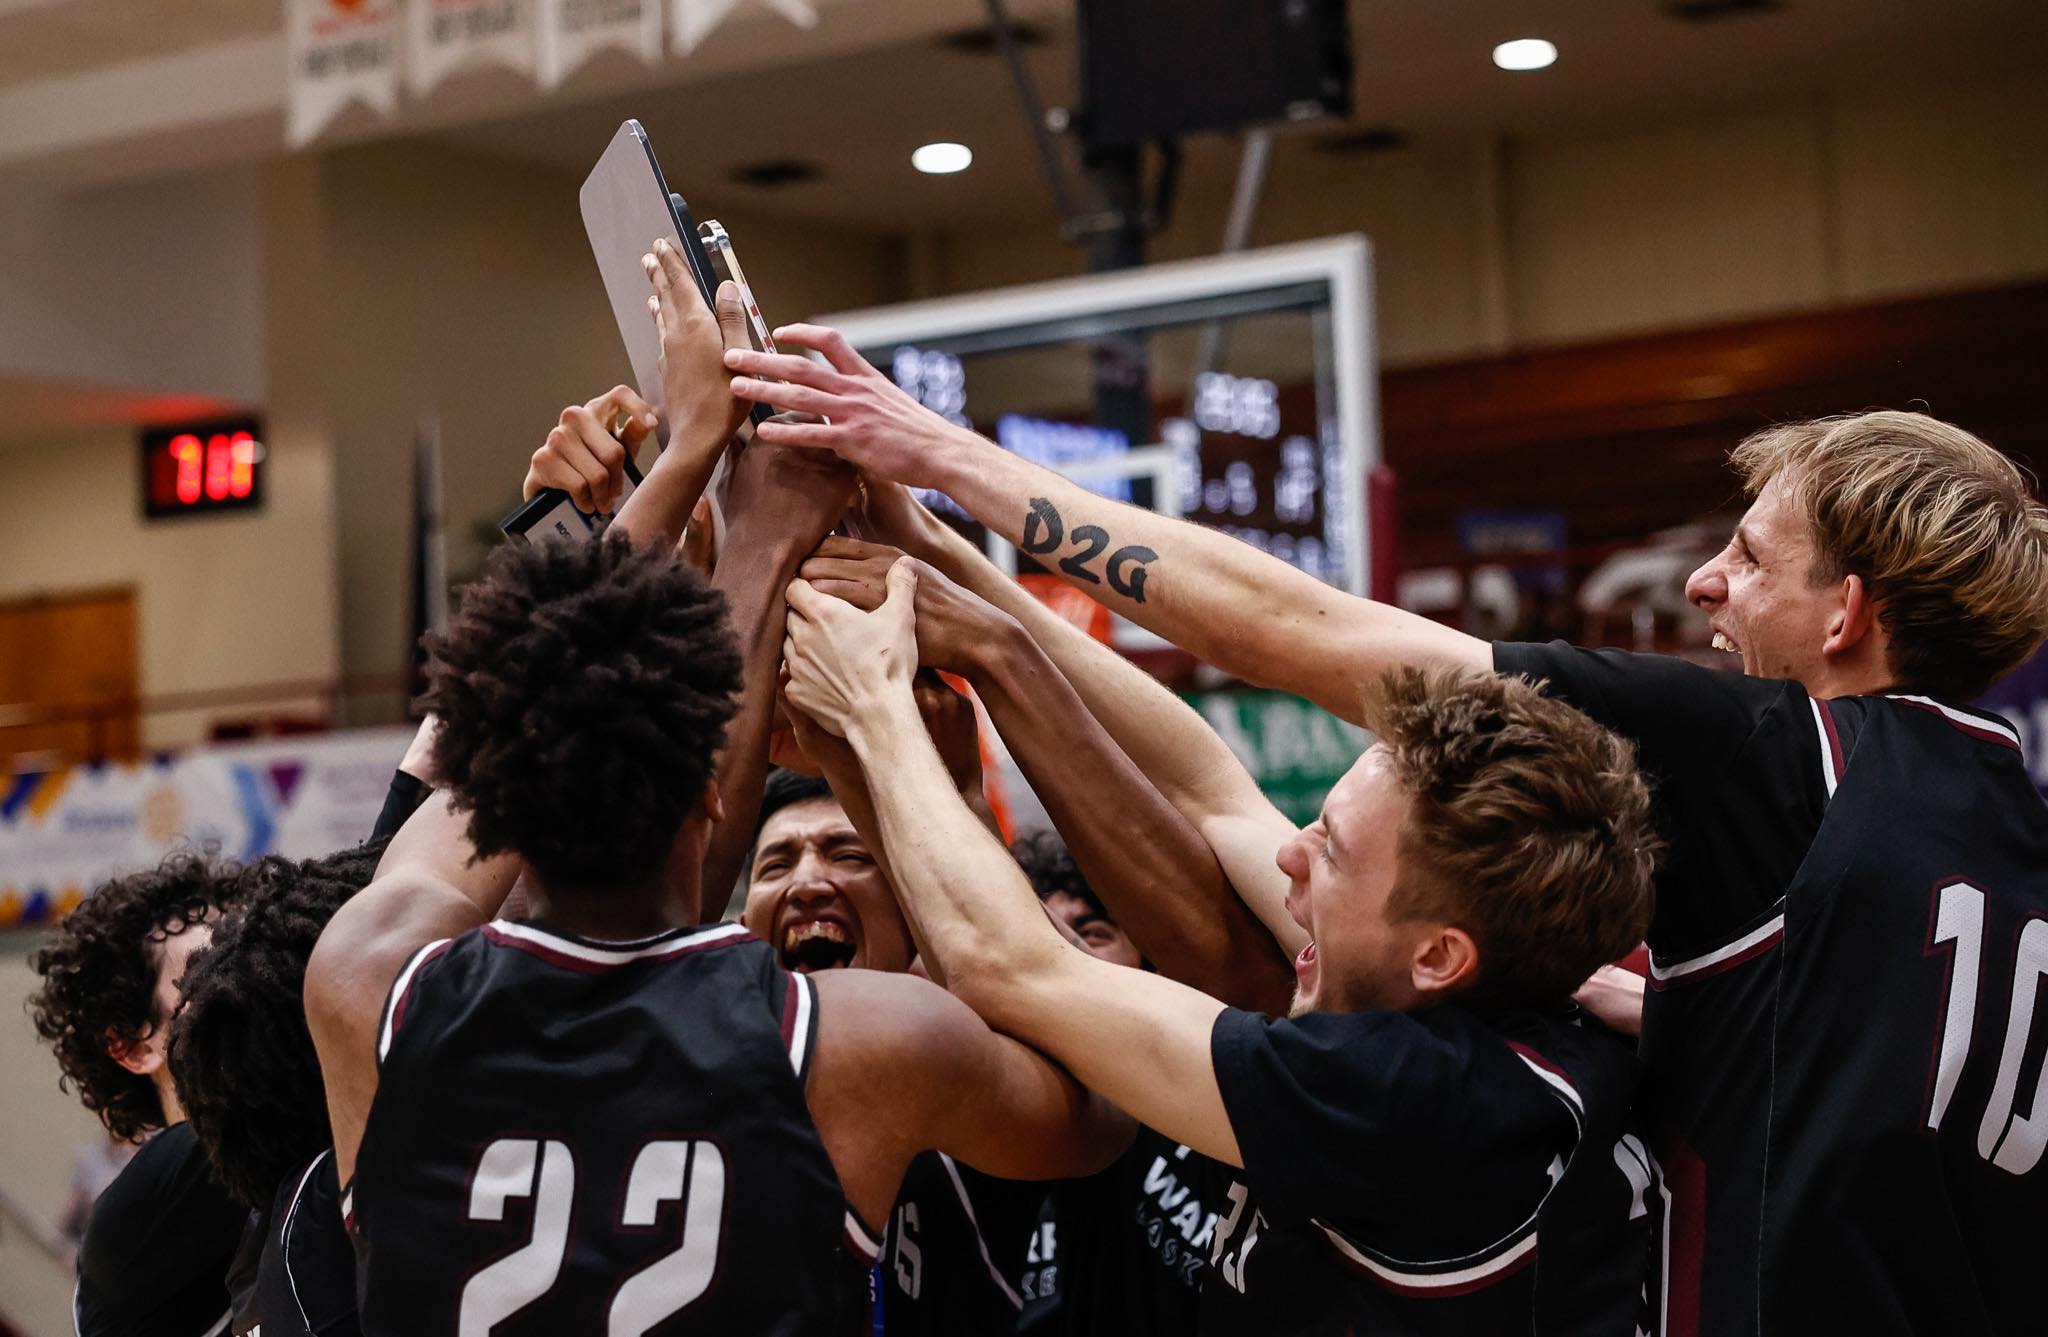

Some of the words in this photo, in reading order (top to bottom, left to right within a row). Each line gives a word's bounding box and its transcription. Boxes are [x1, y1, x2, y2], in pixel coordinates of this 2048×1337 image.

[1021, 497, 1160, 604] D2G
[1927, 882, 2048, 1176] 10
[458, 1138, 726, 1337] 22
